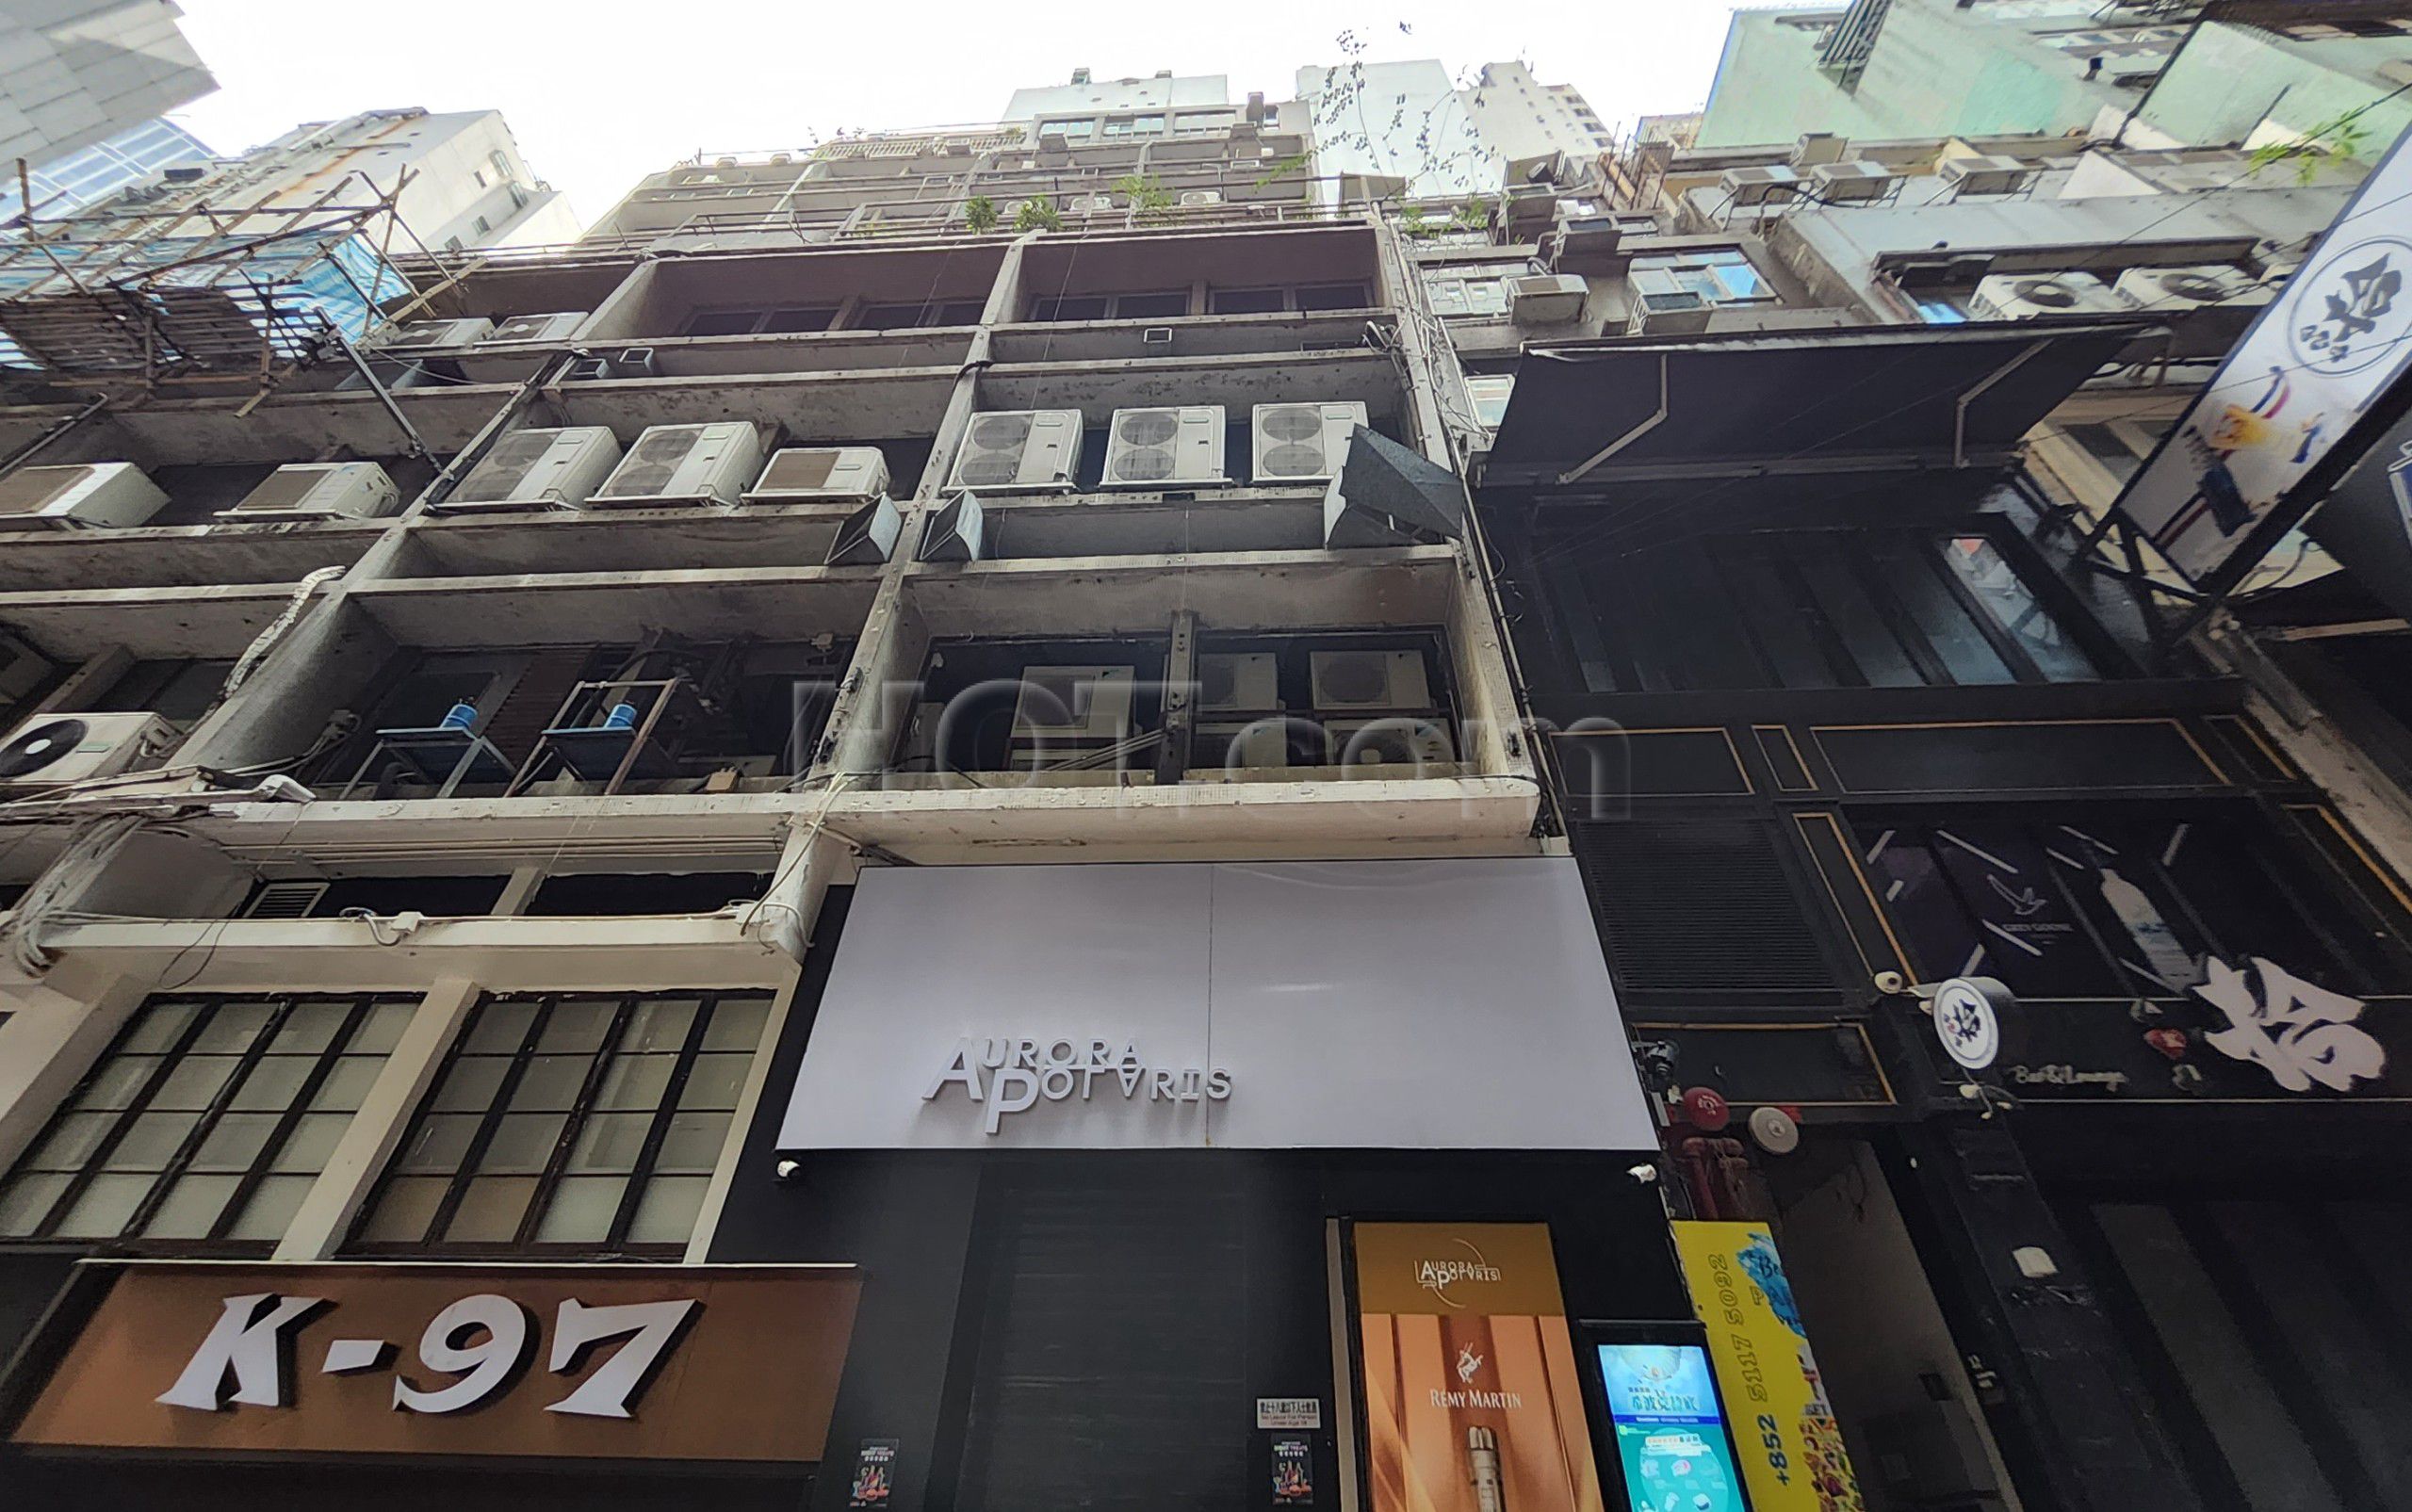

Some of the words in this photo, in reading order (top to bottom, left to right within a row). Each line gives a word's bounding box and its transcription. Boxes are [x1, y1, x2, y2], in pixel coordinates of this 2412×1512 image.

[921, 1036, 1143, 1101] AURORA
[1707, 1254, 1744, 1326] 5092
[153, 1292, 700, 1420] K-97
[1730, 1334, 1768, 1404] 5117
[1468, 1389, 1523, 1409] MARTIN
[1755, 1413, 1791, 1487] +852
